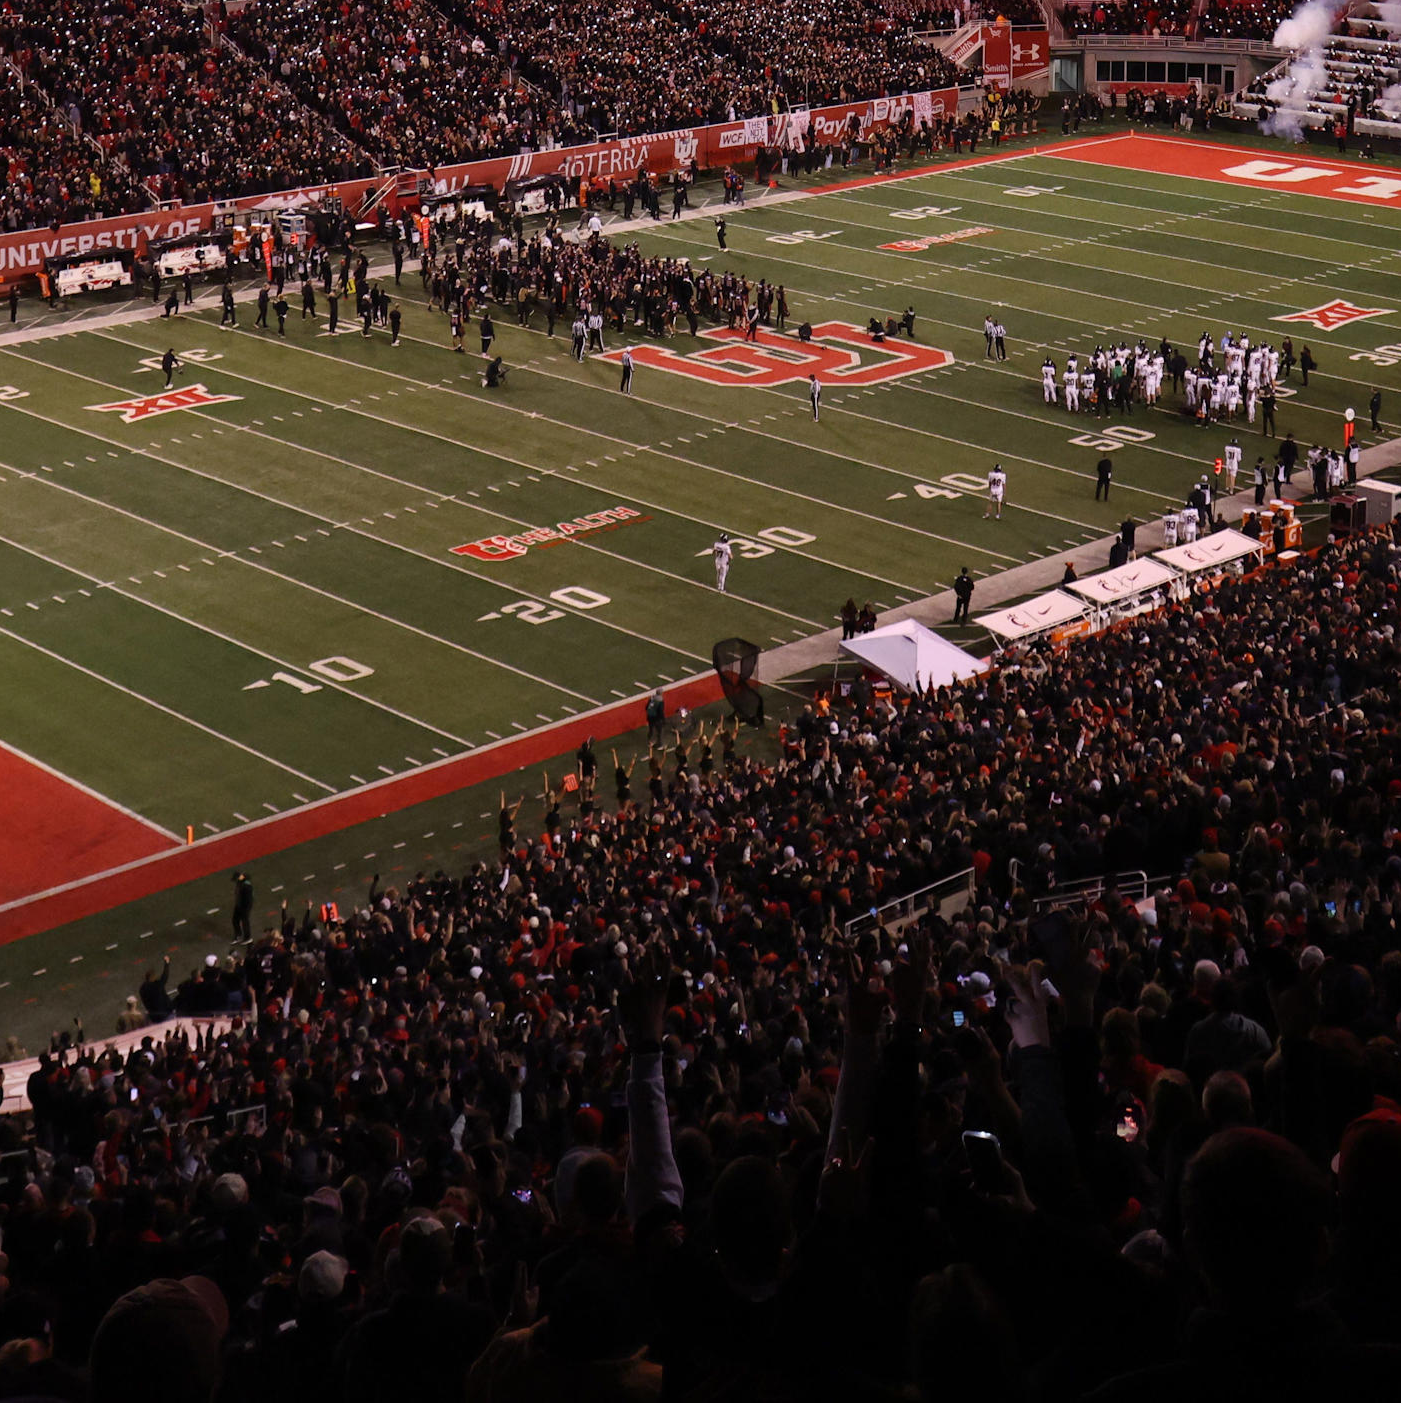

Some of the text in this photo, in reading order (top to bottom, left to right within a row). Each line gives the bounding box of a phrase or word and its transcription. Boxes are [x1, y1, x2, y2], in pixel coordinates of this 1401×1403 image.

[985, 63, 1008, 73] Smith's
[723, 132, 743, 145] WCF
[1067, 425, 1157, 452] 50
[912, 473, 990, 500] 40
[514, 505, 642, 545] HEALTH
[503, 586, 611, 625] 20
[270, 655, 375, 694] 10
